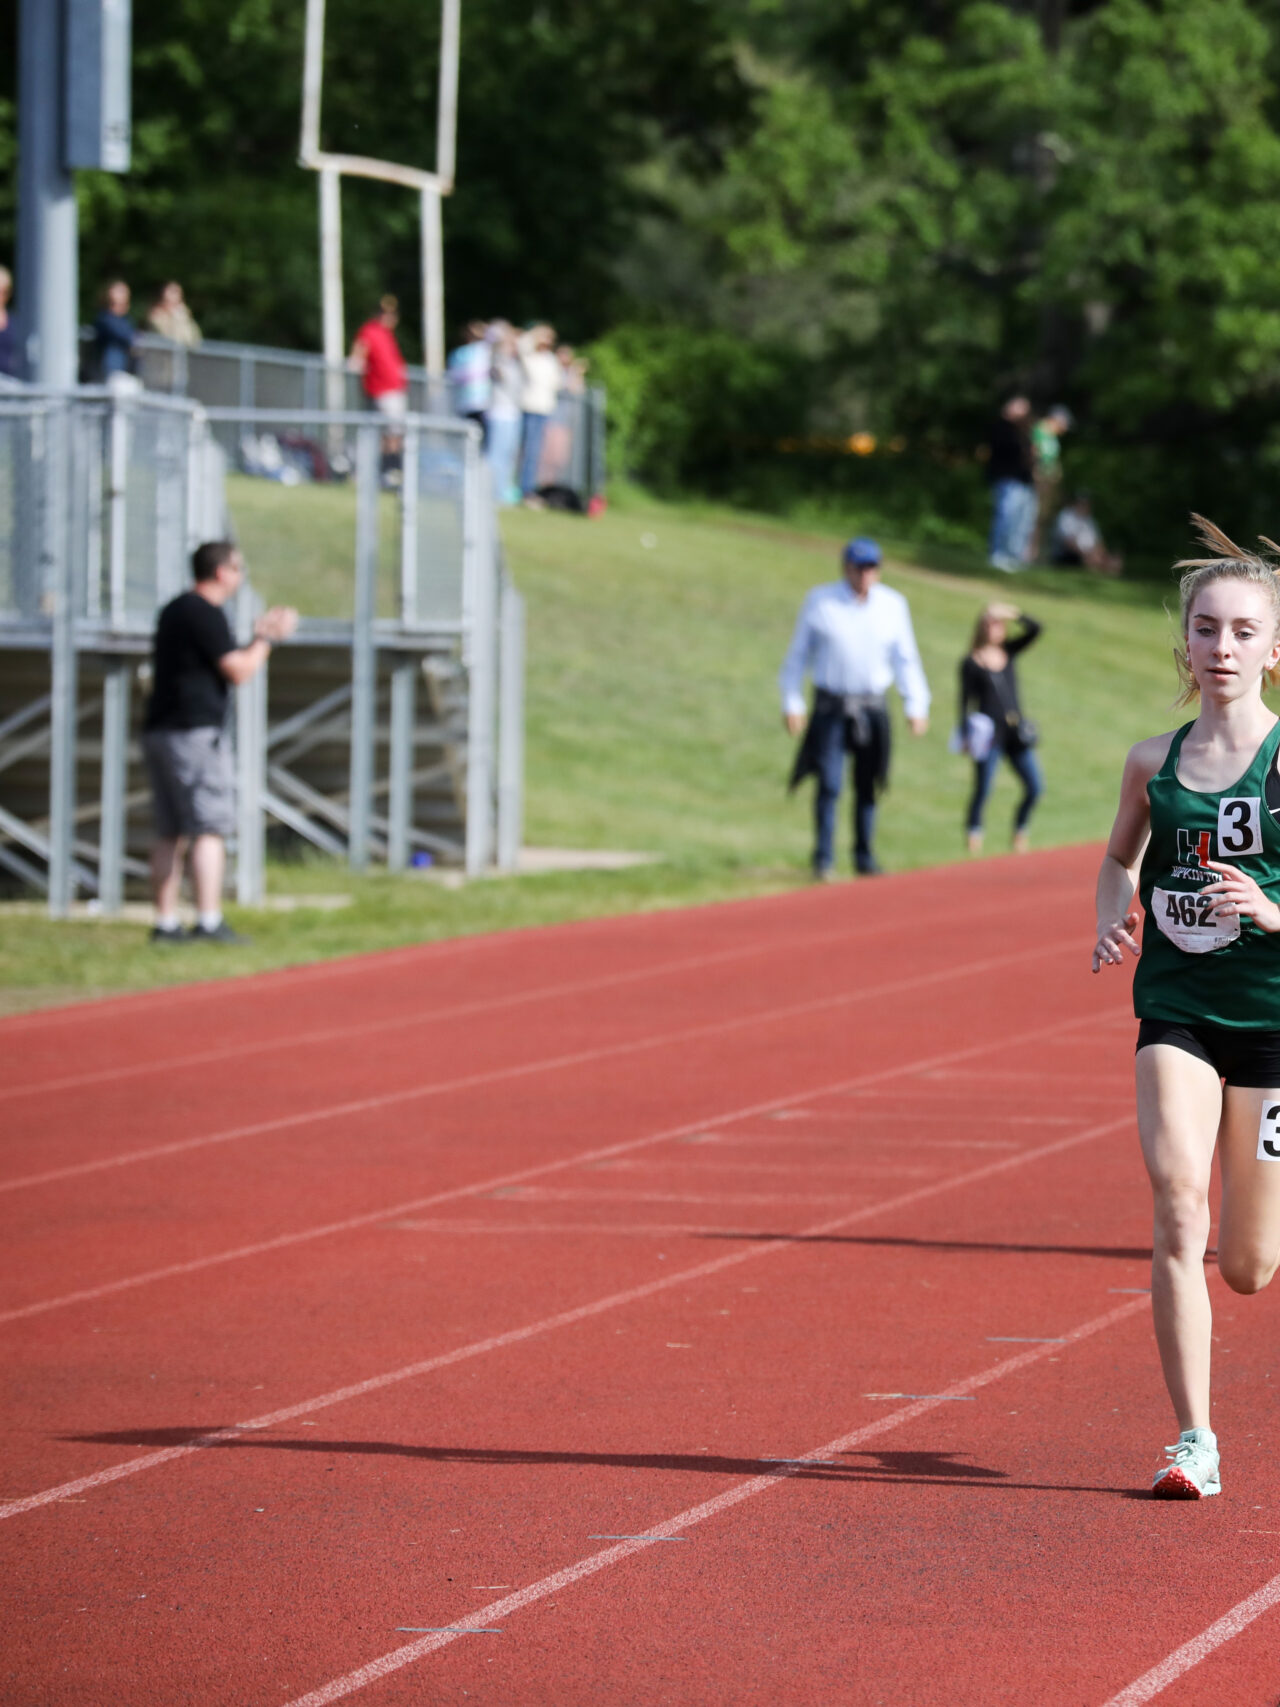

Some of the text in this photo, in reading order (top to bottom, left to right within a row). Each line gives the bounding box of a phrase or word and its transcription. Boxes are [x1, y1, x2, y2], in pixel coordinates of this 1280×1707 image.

[1222, 800, 1254, 852] 3
[1177, 828, 1211, 870] H
[1165, 894, 1217, 928] 462
